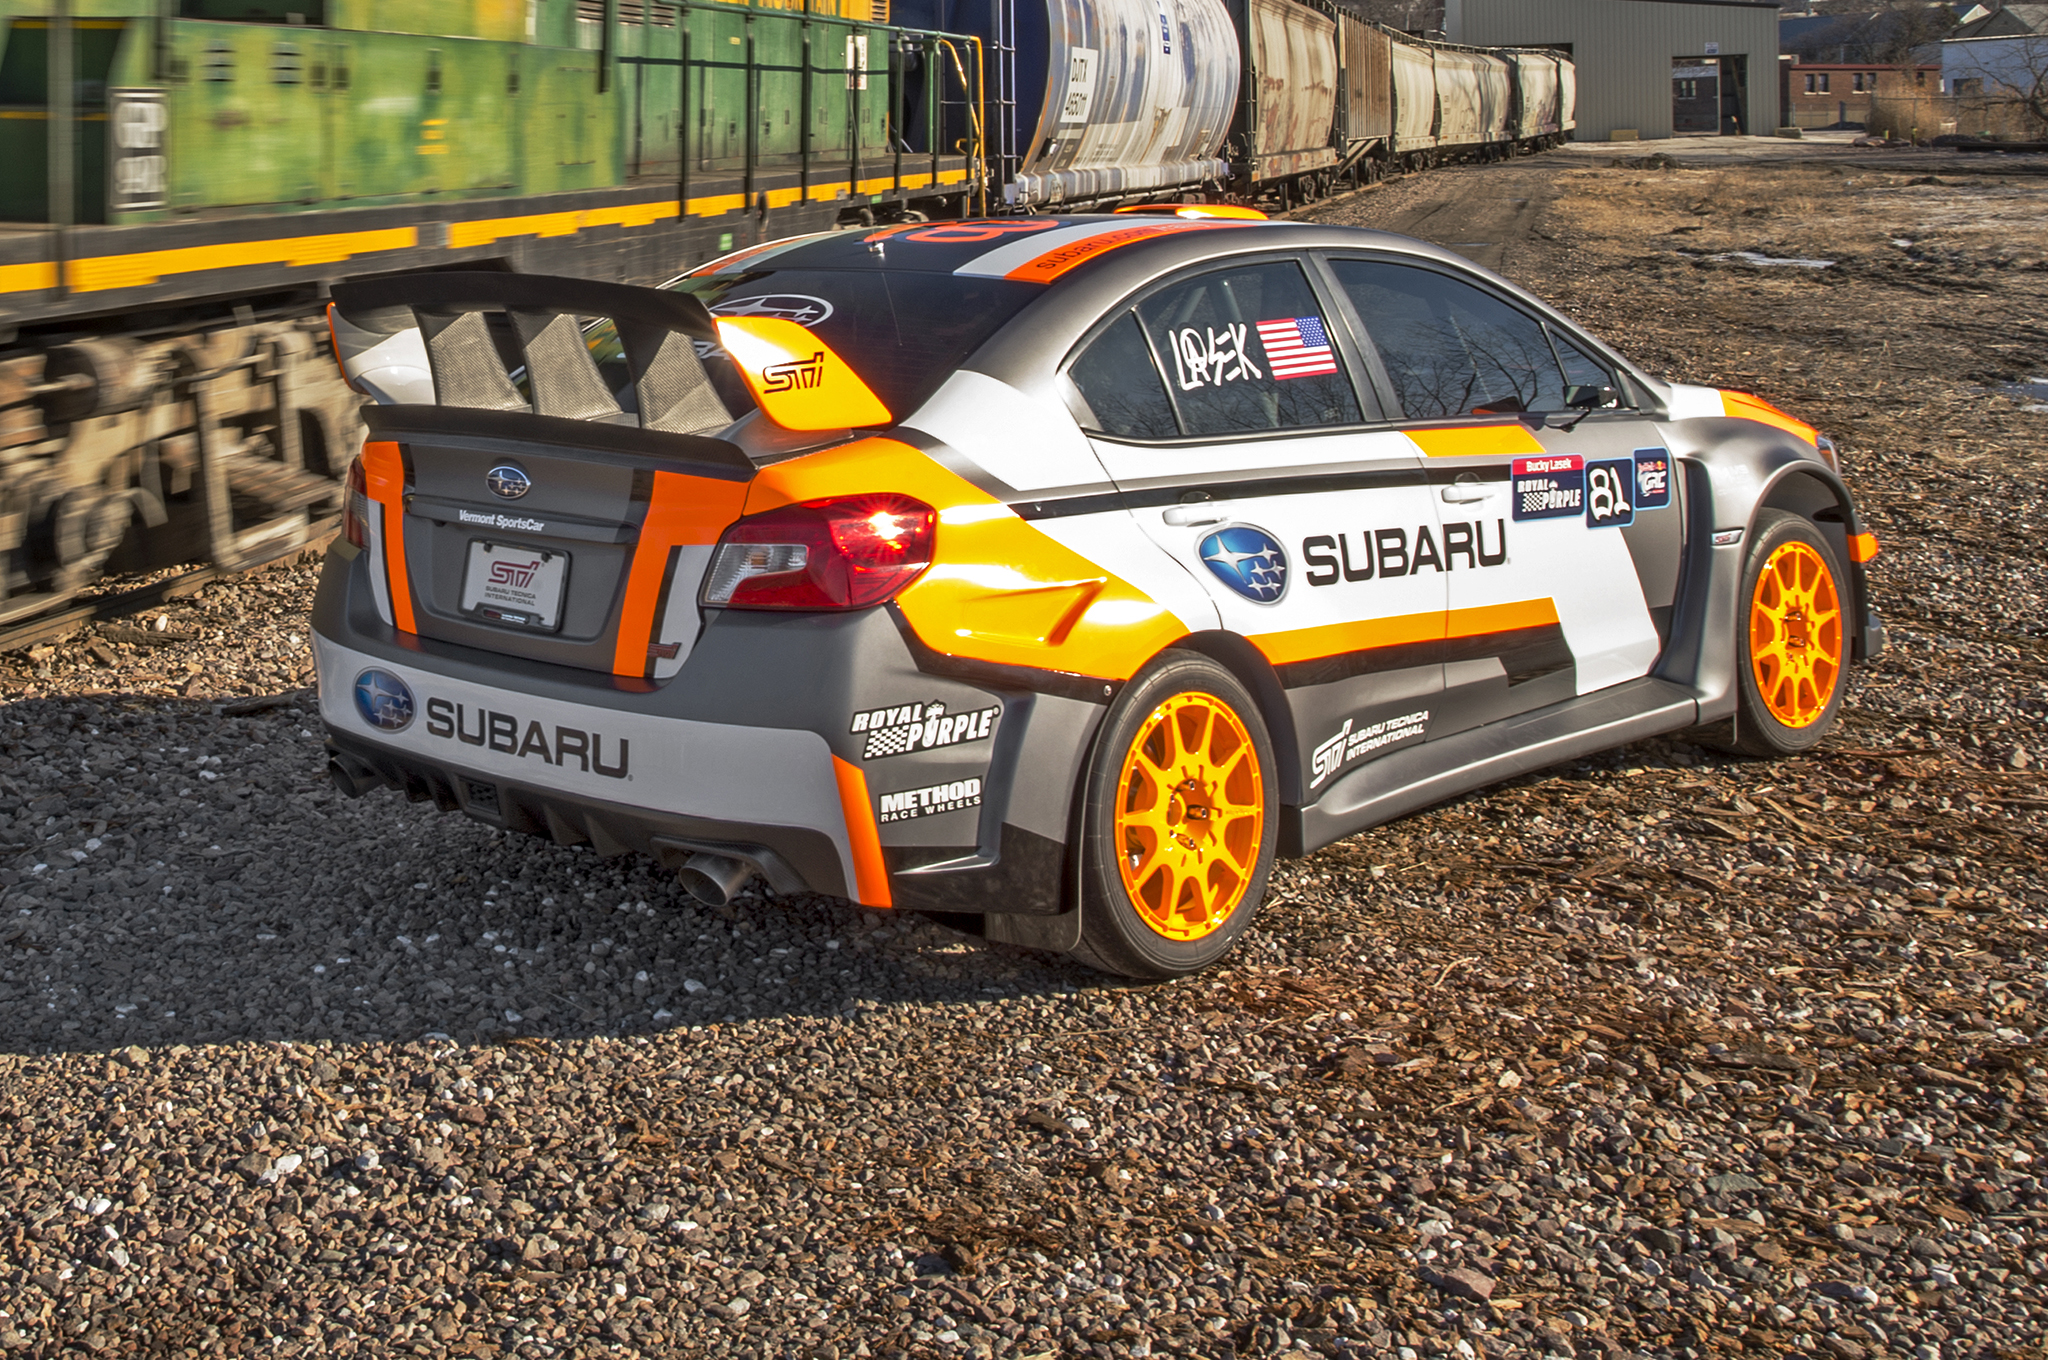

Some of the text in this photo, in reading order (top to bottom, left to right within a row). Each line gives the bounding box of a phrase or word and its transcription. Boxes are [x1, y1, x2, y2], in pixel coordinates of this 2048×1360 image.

[1071, 58, 1088, 82] DJTX
[1526, 458, 1572, 473] Bucky Lasek
[1517, 479, 1549, 493] ROYAL
[1541, 489, 1581, 510] PURPLE
[1589, 467, 1631, 521] 81
[459, 509, 545, 532] Vermont SportsCar
[1302, 518, 1506, 587] SUBARU
[484, 592, 535, 606] INTERNATIONAL
[485, 585, 536, 599] SUBARU TECNICA
[851, 703, 922, 732] ROYAL
[905, 709, 993, 752] PURPLE
[1347, 710, 1429, 746] SUBARU TECNICA
[426, 697, 629, 780] SUBARU
[1345, 723, 1425, 761] INTERNATIONAL
[880, 778, 981, 814] METHOD
[880, 796, 981, 822] RACE WHEELS
